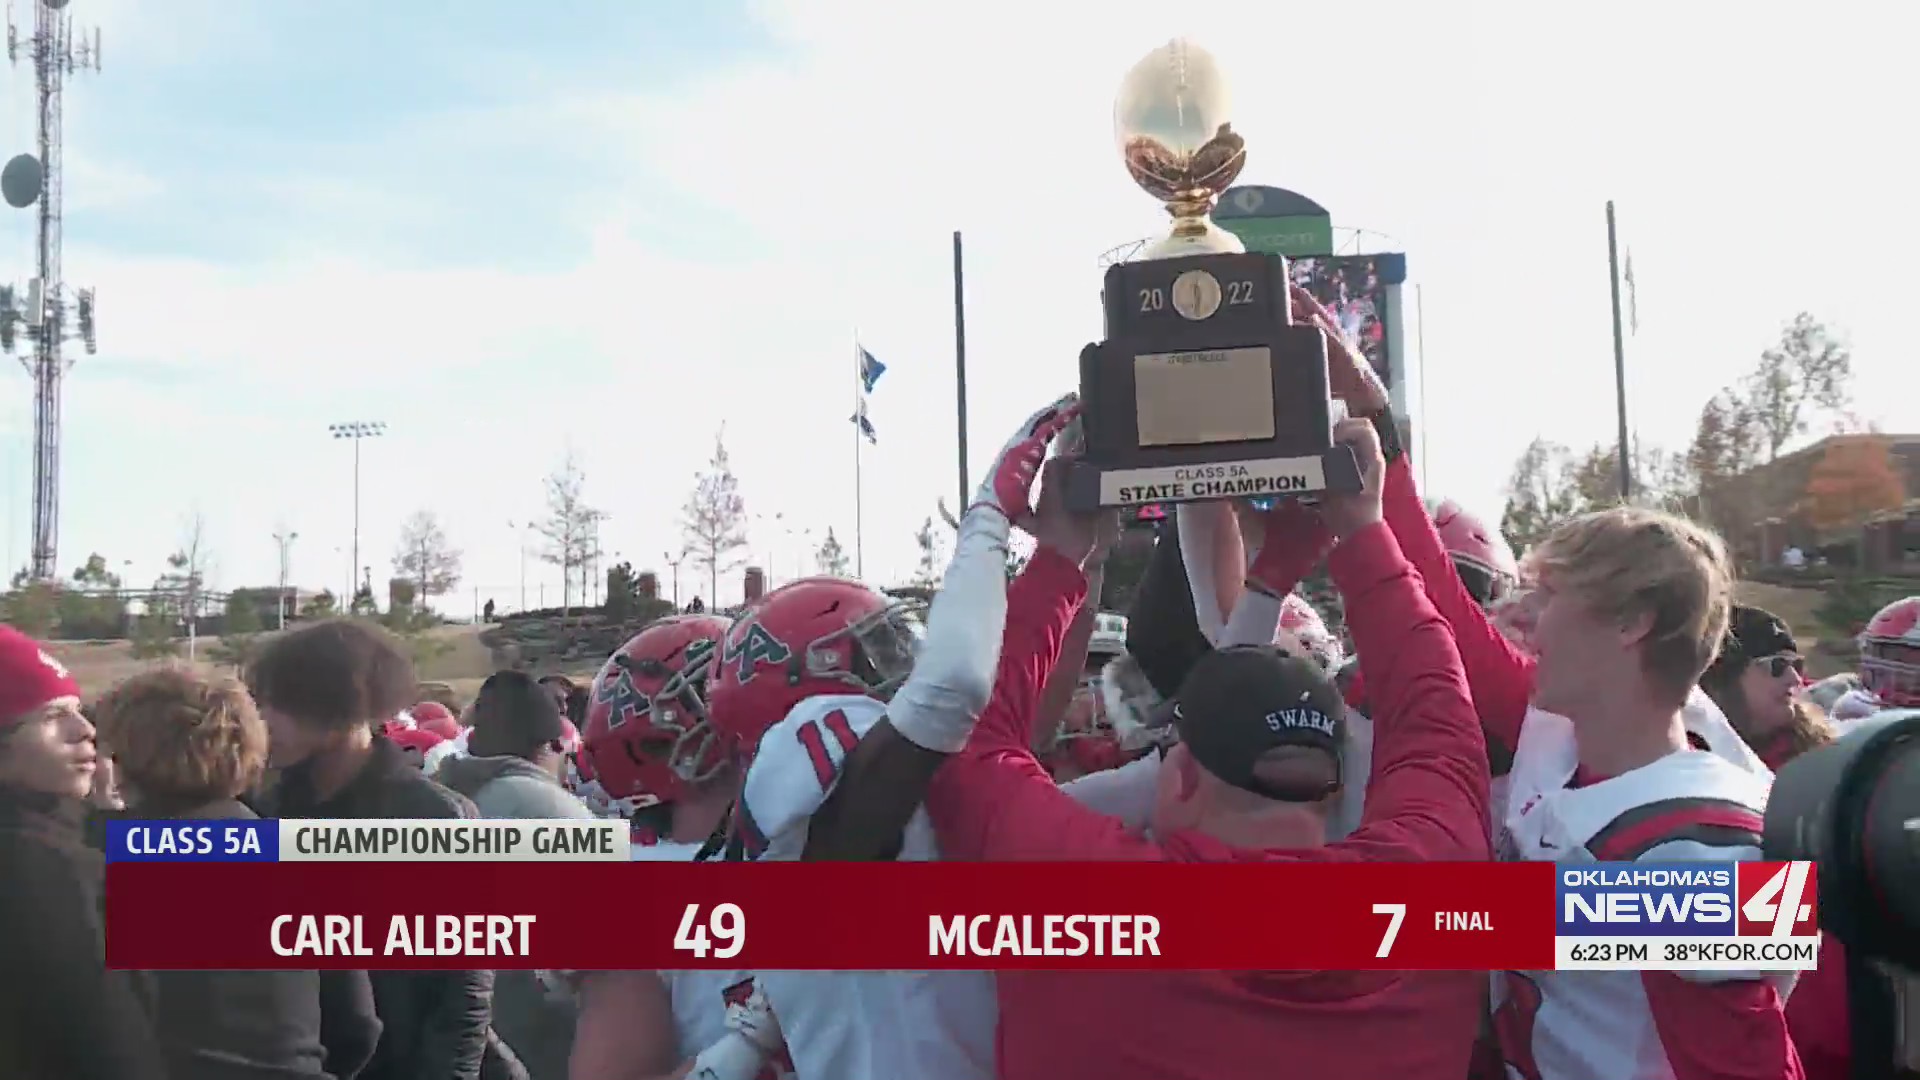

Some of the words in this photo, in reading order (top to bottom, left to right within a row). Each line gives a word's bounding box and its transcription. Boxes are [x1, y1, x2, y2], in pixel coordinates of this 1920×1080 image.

[1140, 288, 1163, 312] 20
[1228, 281, 1254, 304] 22
[1175, 466, 1225, 481] CLASS
[1230, 465, 1249, 478] 5A
[1119, 483, 1185, 502] STATE
[1191, 475, 1307, 496] CHAMPION
[1265, 708, 1336, 737] SWARM
